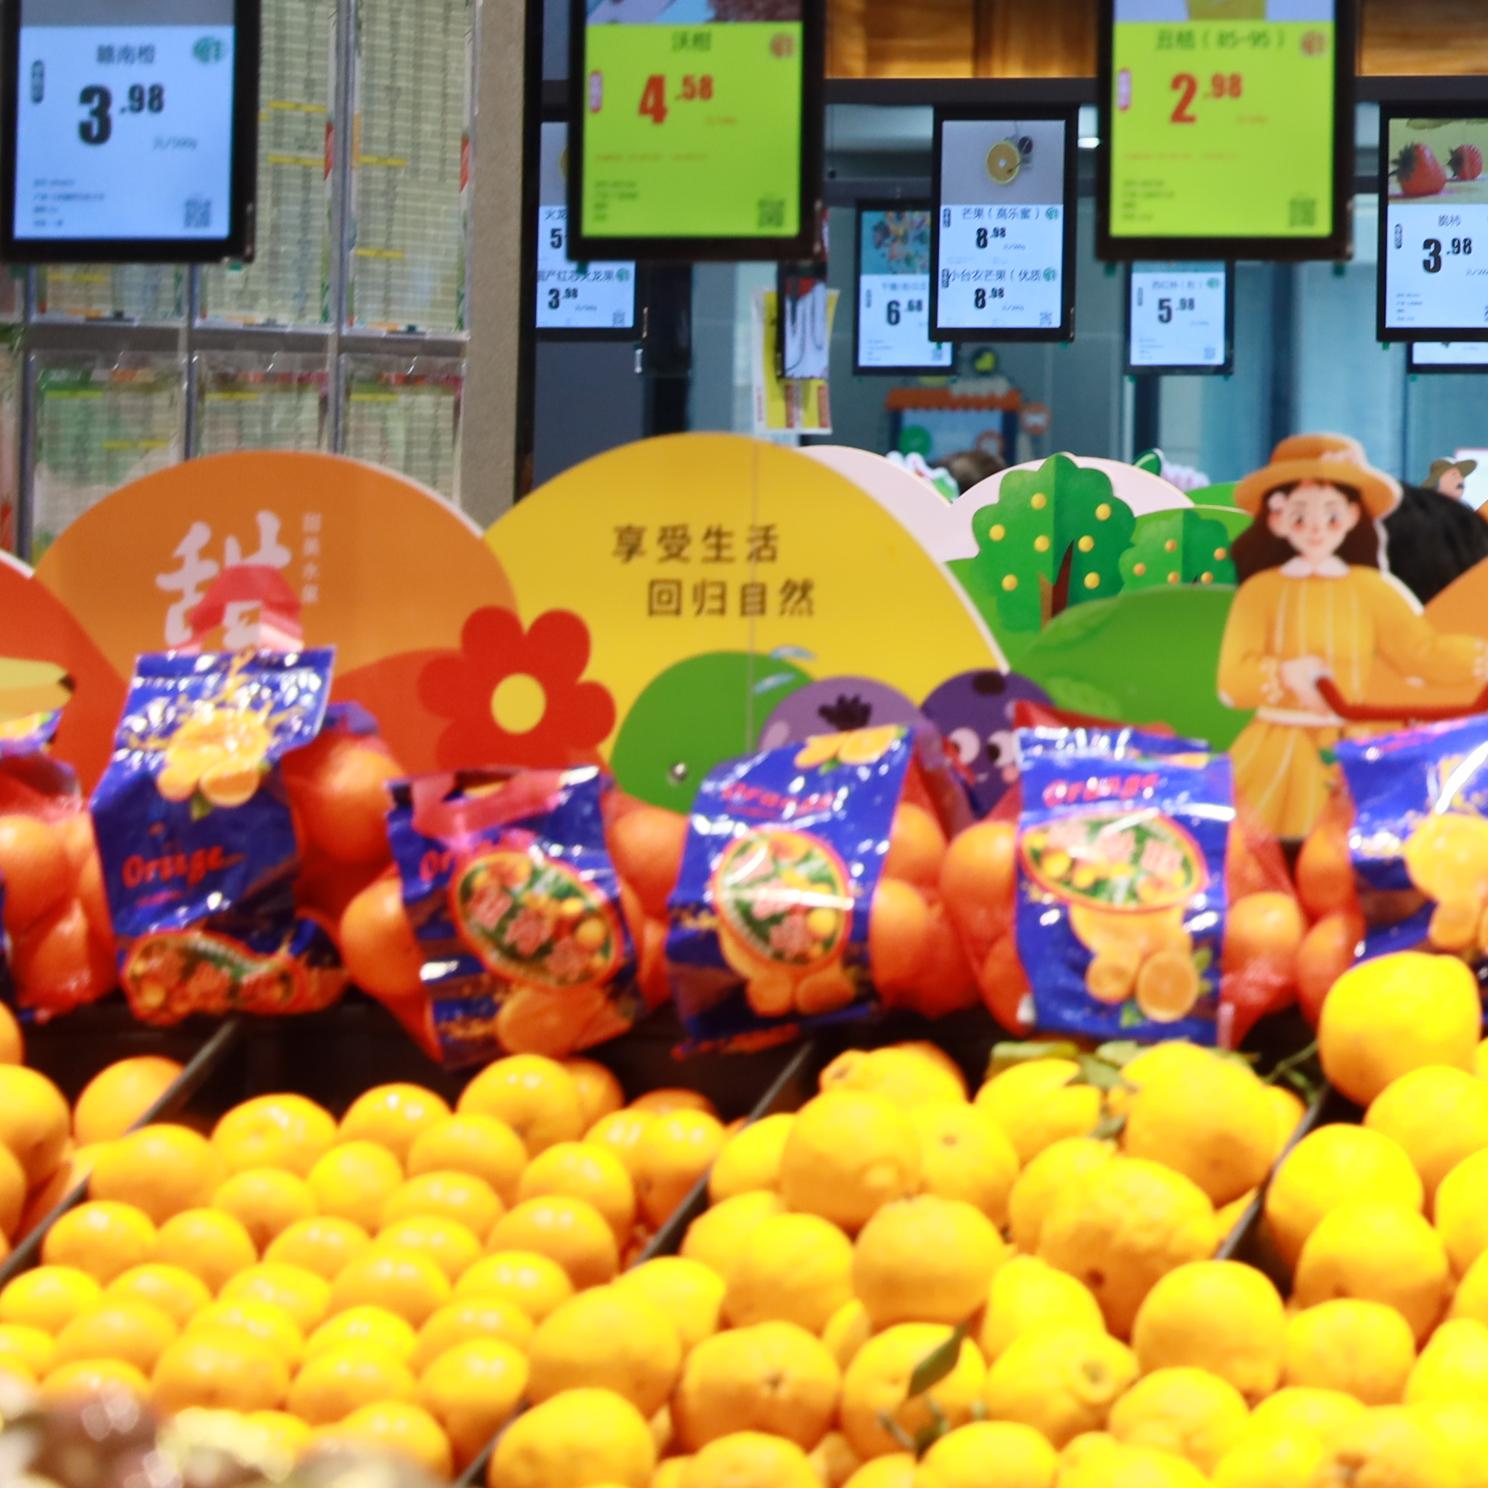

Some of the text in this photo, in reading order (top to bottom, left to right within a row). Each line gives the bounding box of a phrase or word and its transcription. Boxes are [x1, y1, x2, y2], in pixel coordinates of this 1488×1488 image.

[78, 83, 165, 146] 3.98
[637, 73, 714, 126] 4.58
[1169, 72, 1243, 124] 2.98
[1422, 237, 1473, 274] 3.98
[1157, 297, 1195, 324] 5.98
[610, 522, 779, 564] 享受生活
[647, 576, 815, 617] 回归自然
